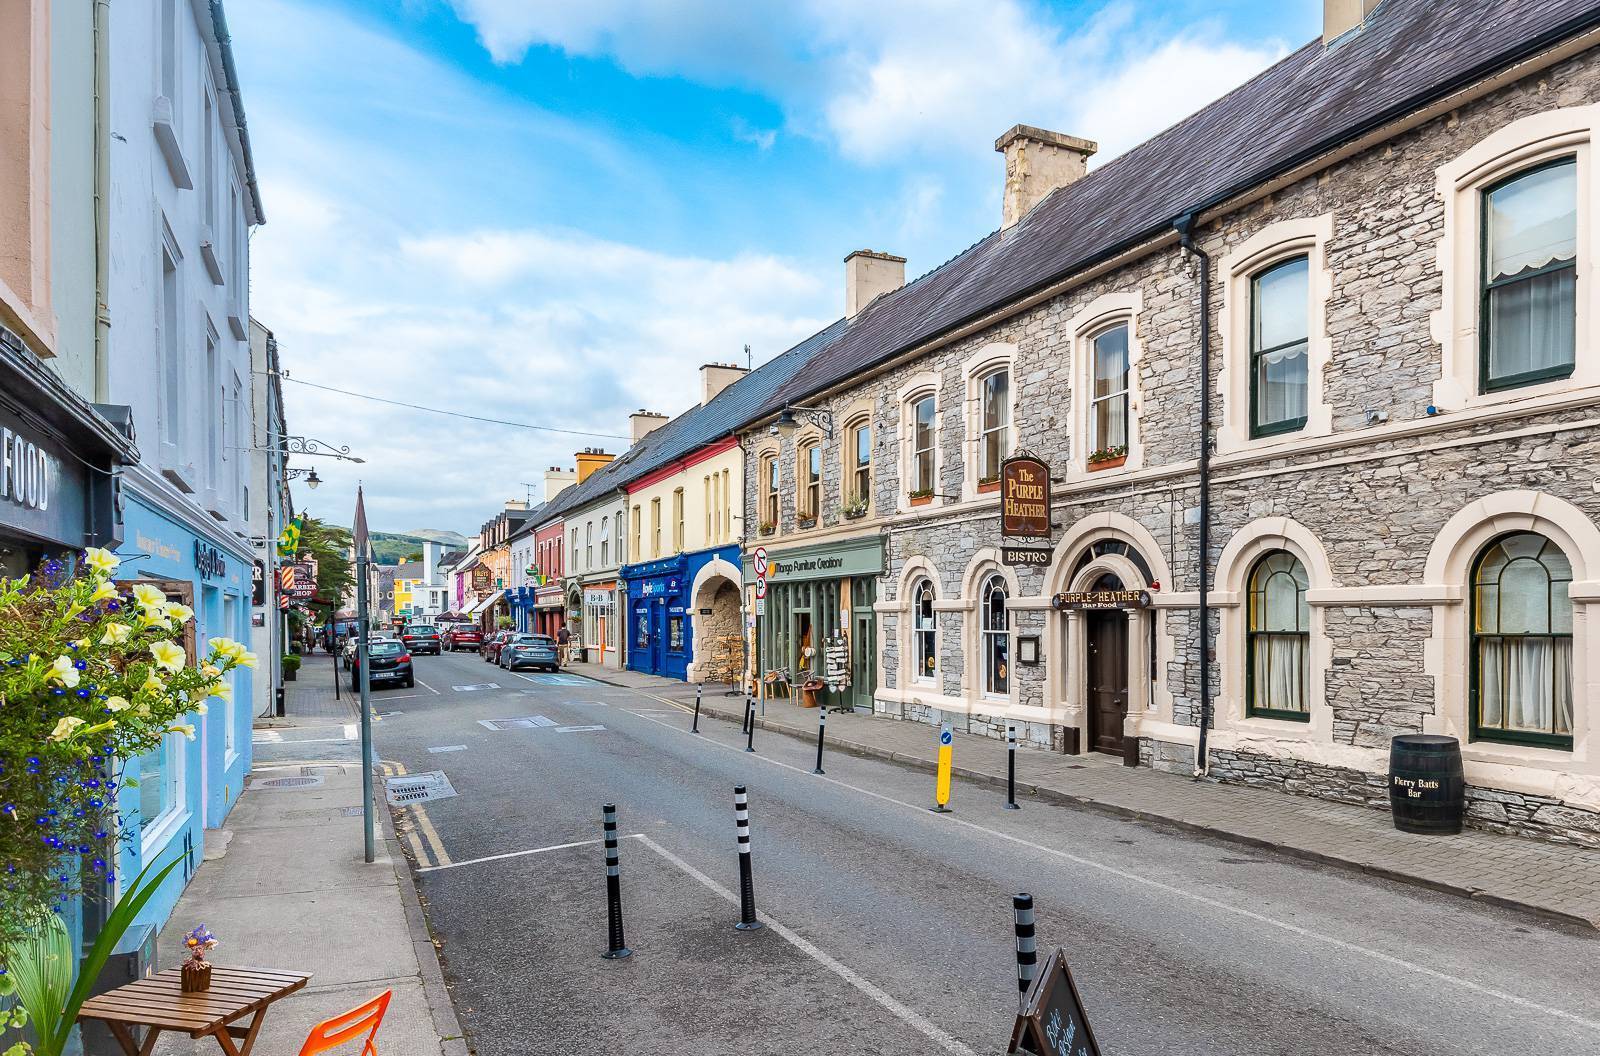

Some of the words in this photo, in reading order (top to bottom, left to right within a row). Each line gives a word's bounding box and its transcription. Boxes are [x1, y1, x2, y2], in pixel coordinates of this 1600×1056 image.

[3, 427, 48, 511] FOOD
[1019, 469, 1034, 481] The
[1008, 479, 1043, 500] PURPLE
[1005, 499, 1046, 517] HEATHER
[1007, 552, 1047, 563] BISTRO
[775, 563, 793, 575] Mango
[1407, 789, 1422, 798] Bar
